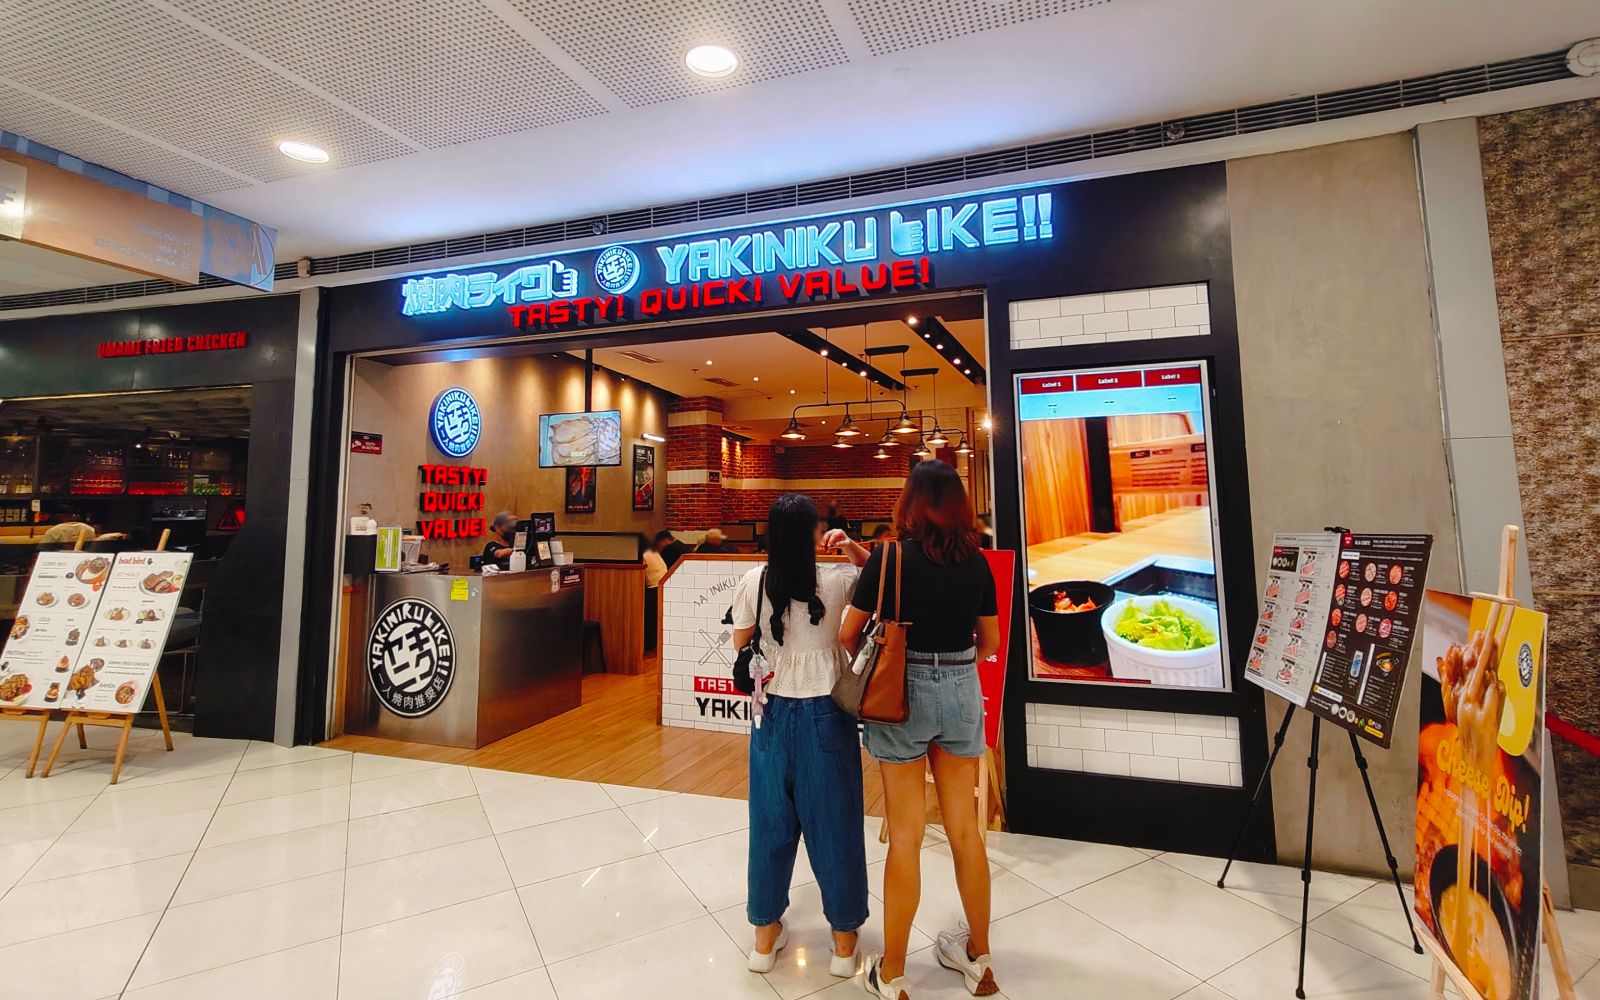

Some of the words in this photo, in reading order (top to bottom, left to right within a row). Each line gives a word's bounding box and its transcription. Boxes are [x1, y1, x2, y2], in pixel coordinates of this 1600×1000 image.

[656, 216, 877, 285] YAKINIKU
[890, 193, 1053, 256] LIKE!!
[508, 294, 624, 328] TASTY!
[641, 276, 762, 315] QUICK!
[778, 258, 930, 298] VALUE!
[97, 339, 142, 358] UMAMI
[144, 332, 183, 354] FRIED
[187, 331, 248, 351] CHICKEN
[422, 465, 488, 486] TASTY!
[424, 492, 485, 513] QUICK!
[421, 518, 486, 540] VALUE!
[132, 557, 146, 565] bird
[371, 603, 424, 670] YAKINIKU
[698, 678, 735, 693] TAST
[695, 696, 753, 721] YAKI
[1436, 739, 1491, 800] Cheese
[1494, 775, 1531, 834] Dip!
